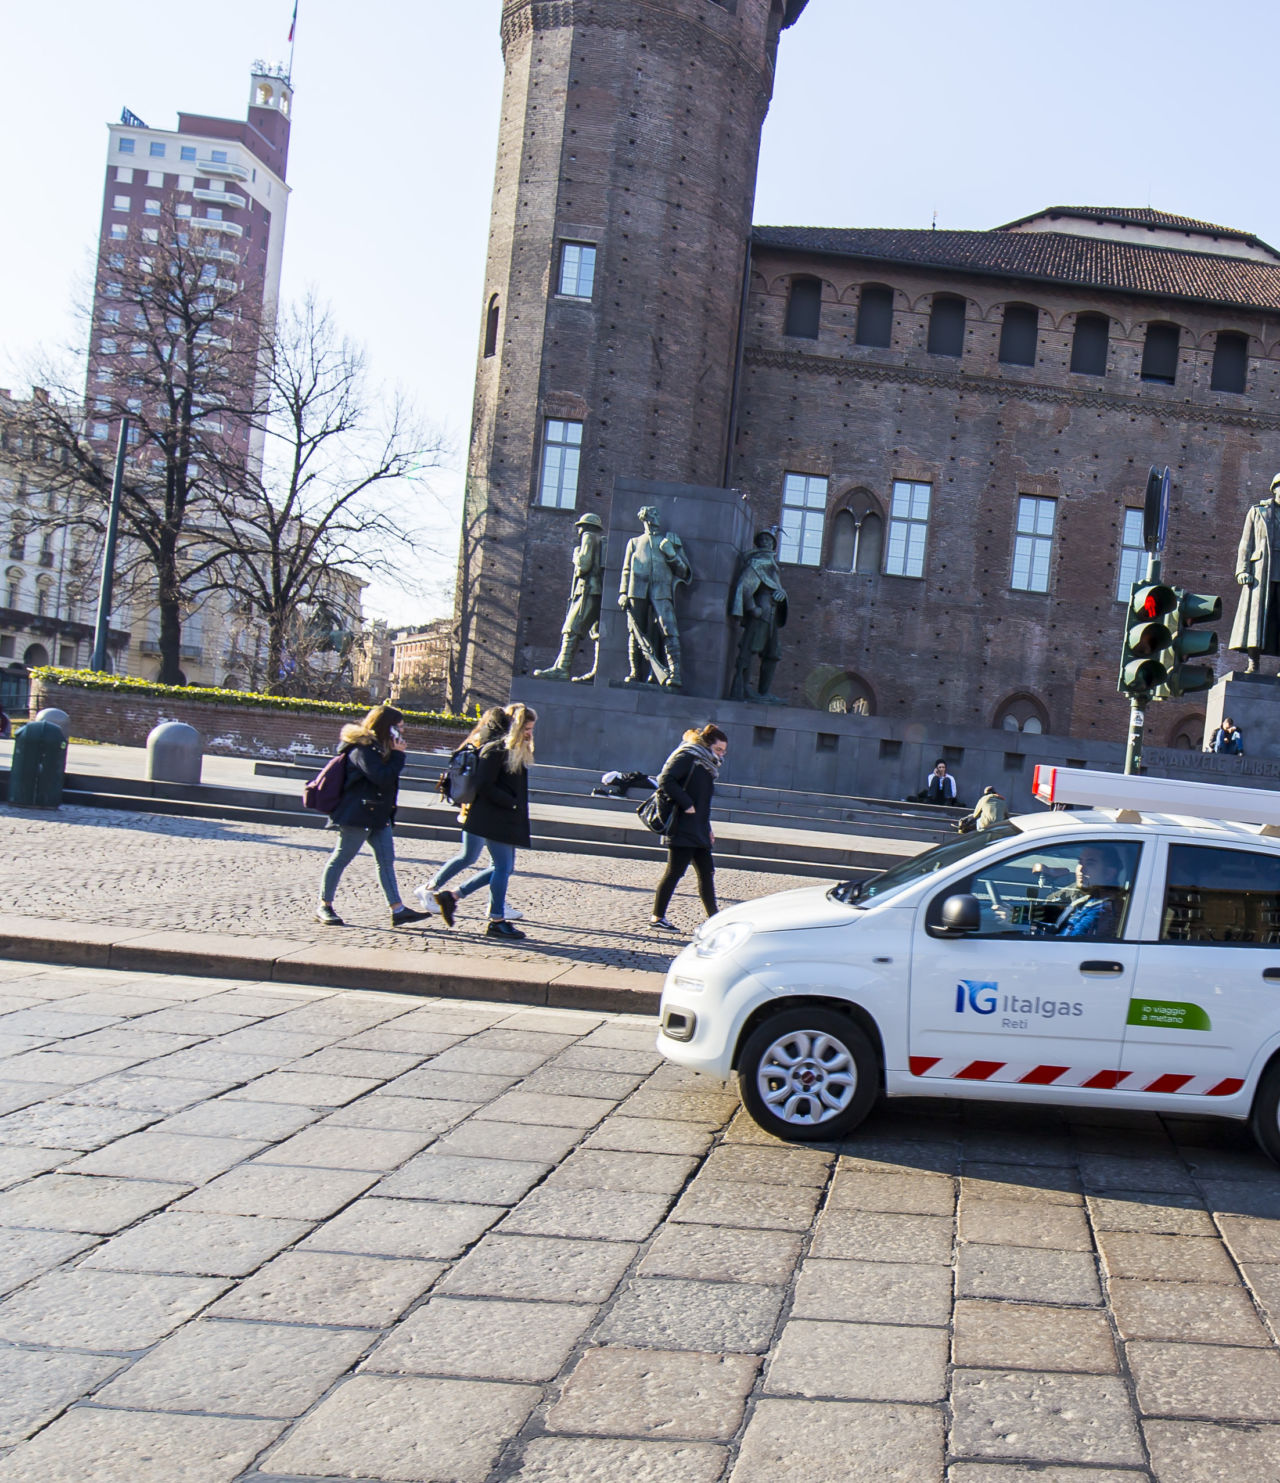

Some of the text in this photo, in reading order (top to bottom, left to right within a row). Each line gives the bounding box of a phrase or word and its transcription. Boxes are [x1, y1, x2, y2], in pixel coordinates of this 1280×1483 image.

[1002, 995, 1083, 1018] Italgas
[1153, 1006, 1187, 1016] viaggio
[1001, 1018, 1028, 1029] Reti
[1149, 1015, 1184, 1024] metano
